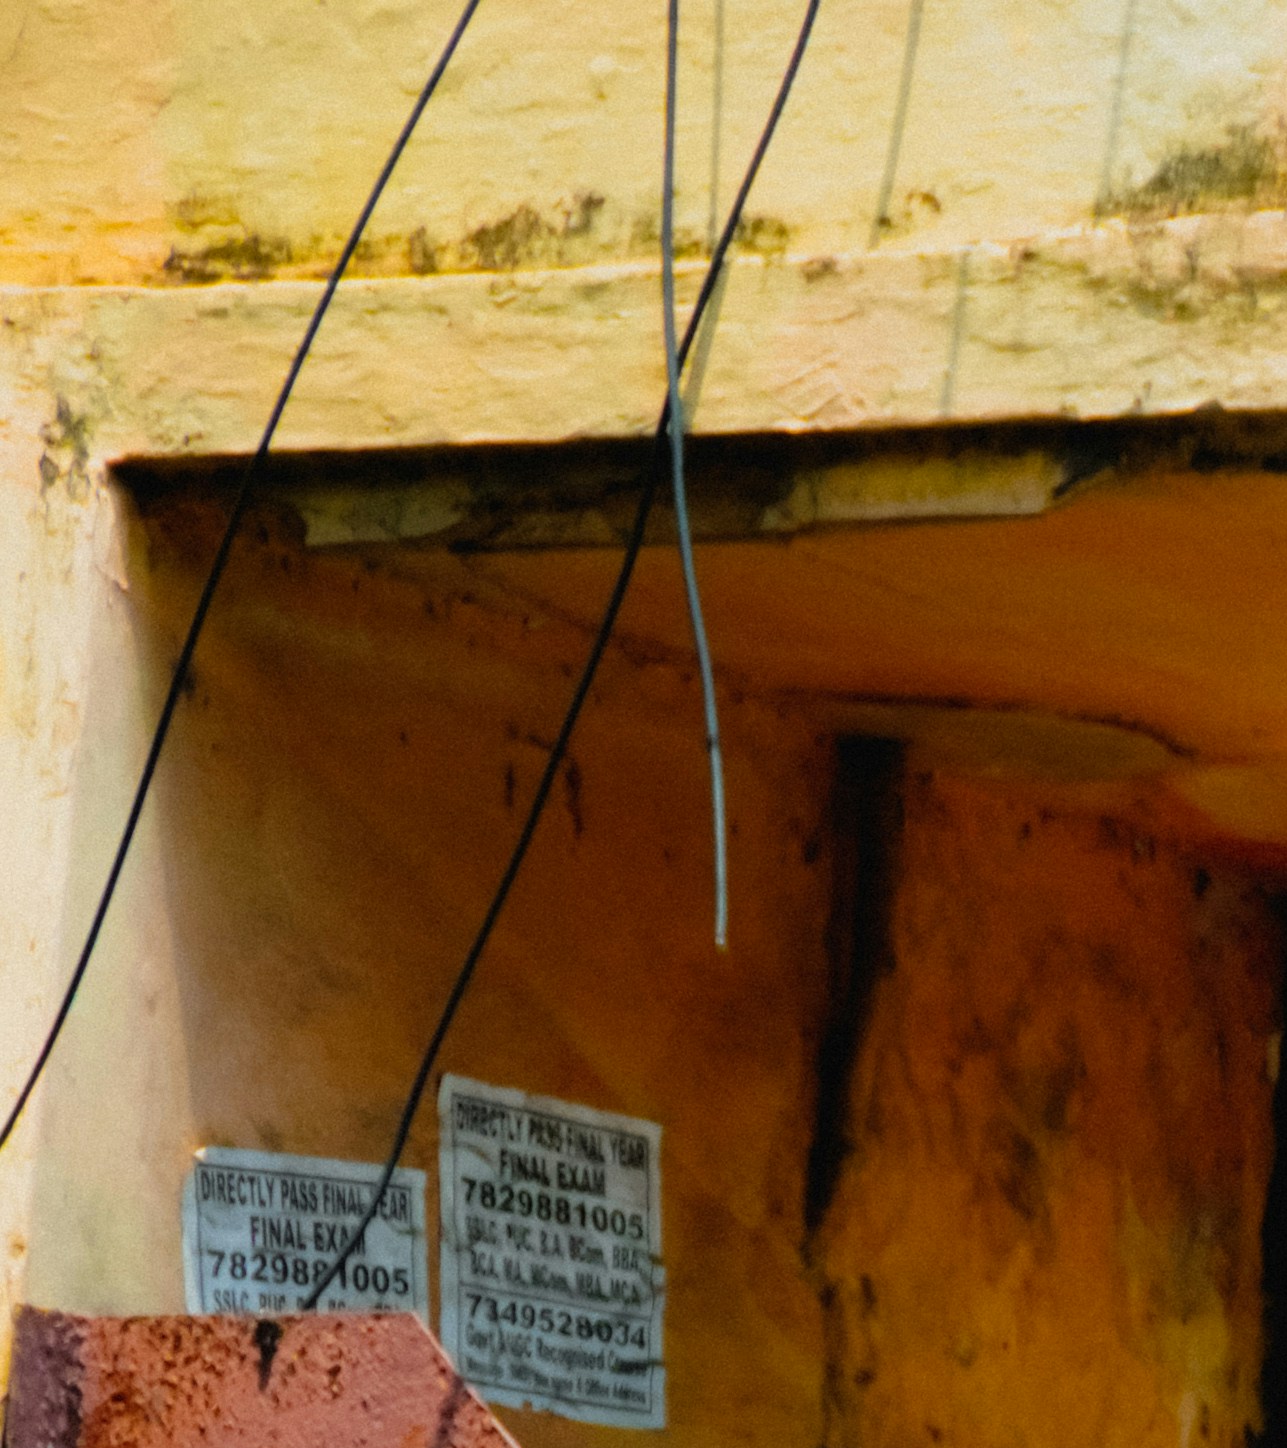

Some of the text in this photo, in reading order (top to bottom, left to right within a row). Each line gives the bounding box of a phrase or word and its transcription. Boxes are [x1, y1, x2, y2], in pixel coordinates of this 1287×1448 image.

[201, 1170, 277, 1208] DIRECTLY
[280, 1179, 318, 1214] PASS
[322, 1184, 367, 1217] FINAL
[500, 1150, 605, 1197] FINAL EXAM
[461, 1176, 644, 1241] 7829881005
[250, 1215, 307, 1251] FINAL
